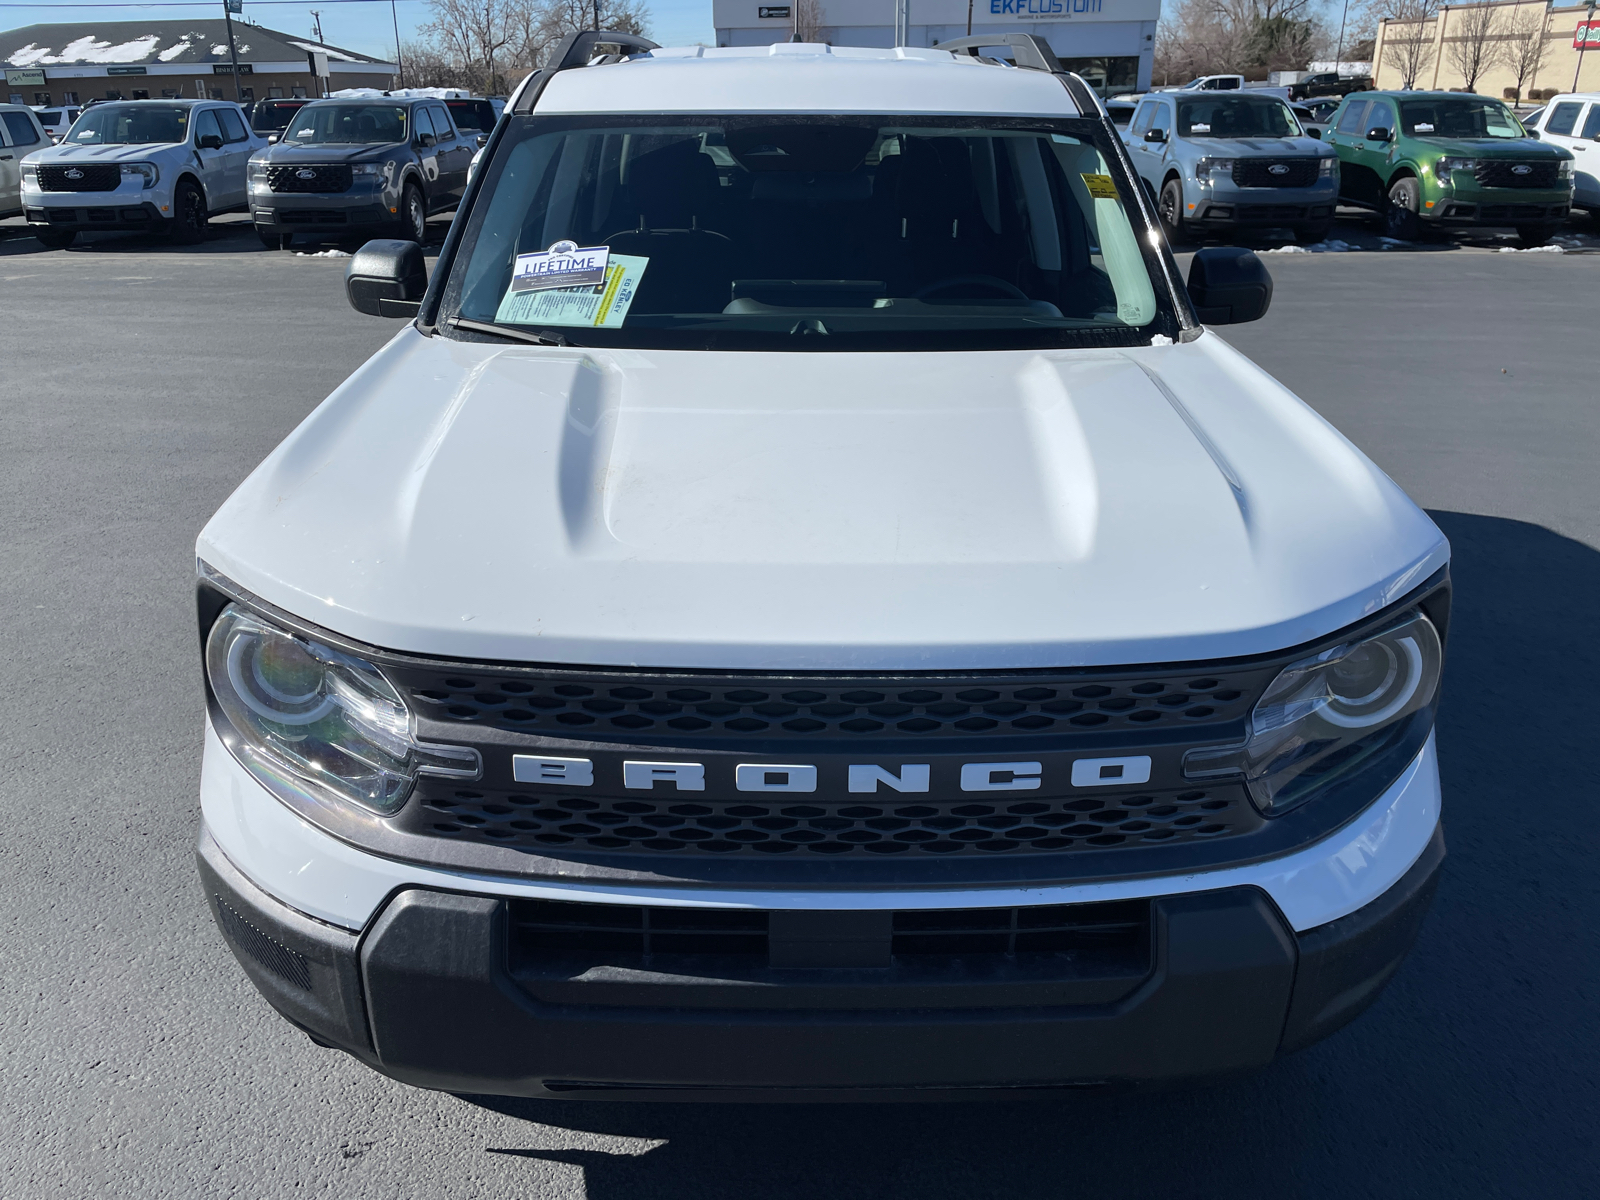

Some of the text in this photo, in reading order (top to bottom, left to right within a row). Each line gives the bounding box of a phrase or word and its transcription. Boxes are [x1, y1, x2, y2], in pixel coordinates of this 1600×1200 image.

[520, 271, 551, 279] POWERTRAIN
[524, 257, 595, 274] LIFETIME
[614, 288, 628, 313] KENLEY
[512, 753, 1152, 793] BRONCO
